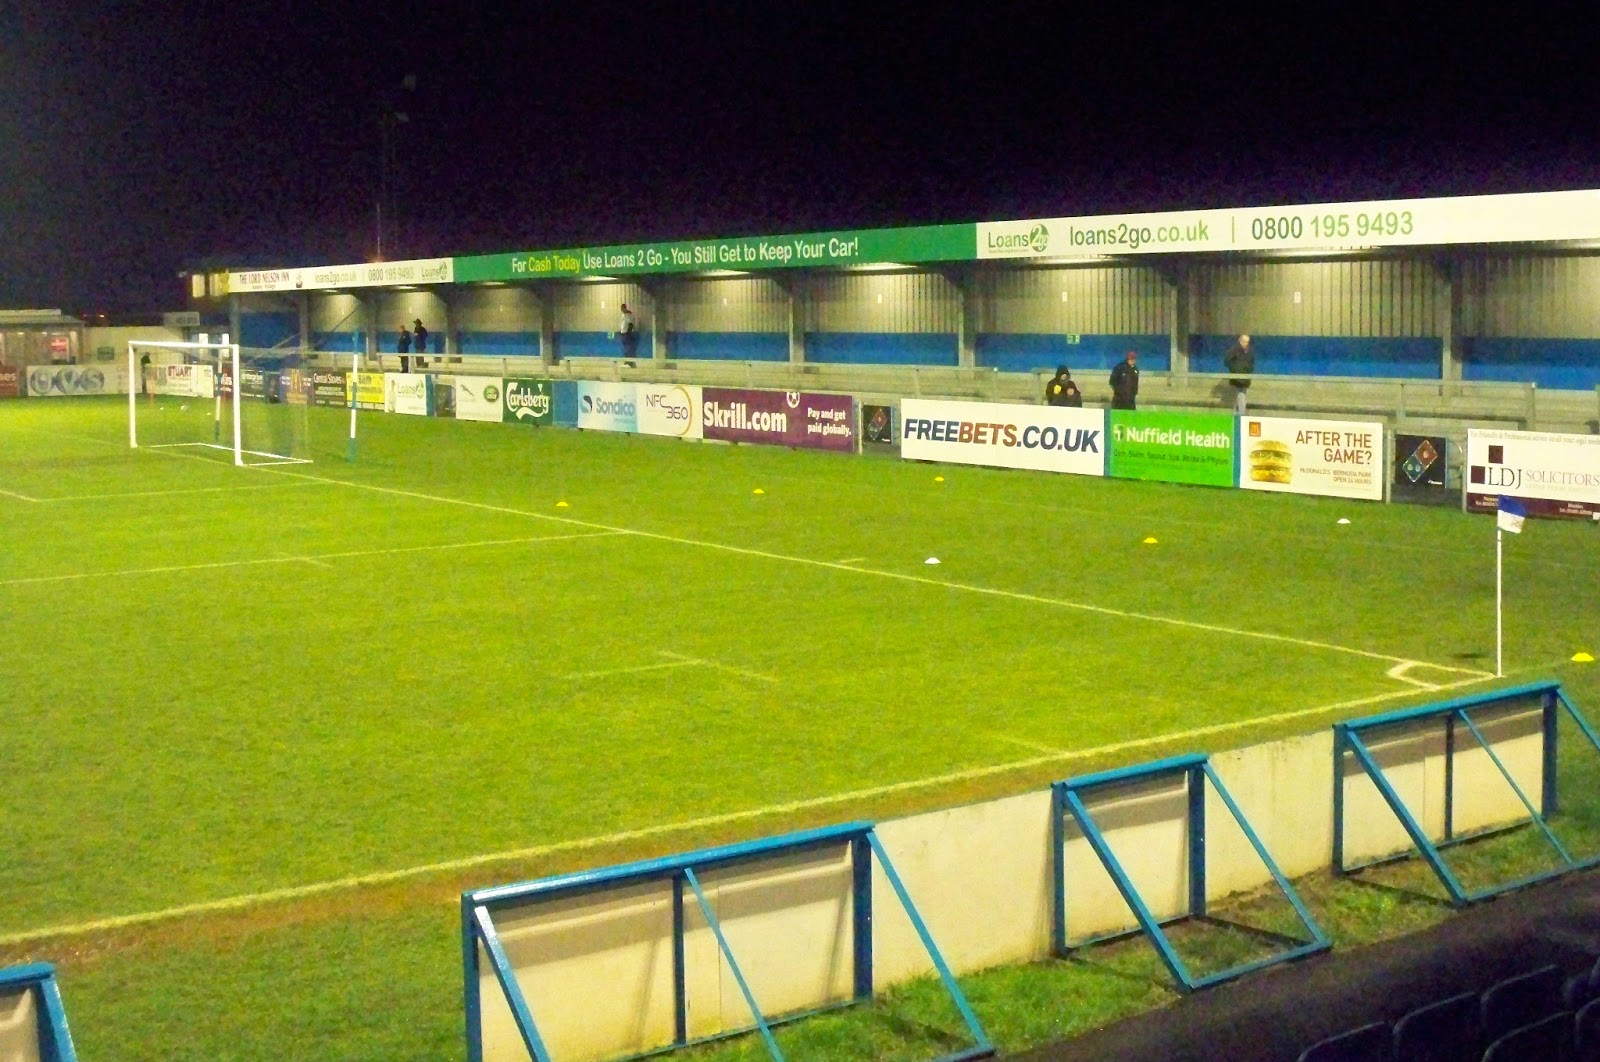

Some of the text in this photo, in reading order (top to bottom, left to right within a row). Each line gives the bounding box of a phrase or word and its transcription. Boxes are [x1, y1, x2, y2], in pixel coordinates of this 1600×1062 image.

[1070, 210, 1414, 249] loans2go.co.uk 0800 195 9493
[511, 257, 527, 273] For
[528, 256, 551, 272] Cash
[553, 254, 581, 273] Today
[583, 253, 603, 270] Use
[604, 251, 635, 269] Loans
[637, 249, 645, 266] 2
[646, 248, 662, 266] Go
[670, 247, 692, 265] You
[694, 245, 717, 264] Still
[719, 244, 742, 263] Get
[743, 243, 757, 262] to
[759, 242, 793, 264] Keep
[794, 239, 825, 259] Your
[828, 236, 859, 258] Car!
[239, 273, 247, 284] THE
[248, 272, 261, 284] LORD
[262, 272, 280, 283] NELSON
[368, 269, 384, 281] 0800
[168, 365, 193, 377] STUART
[505, 381, 550, 414] Carlsberg
[595, 396, 635, 416] Sondico
[645, 393, 667, 408] NFC
[666, 406, 689, 420] 360
[703, 401, 787, 433] Skrill.com
[807, 407, 846, 422] Pay and get
[807, 422, 852, 437] paid globally.
[903, 418, 1101, 454] FREEBETS.CO.UK
[1126, 426, 1230, 449] Nuffield Health
[1295, 429, 1373, 449] AFTER THE
[1323, 448, 1373, 465] GAME?
[1487, 467, 1522, 489] LDJ
[1525, 469, 1600, 487] SOLICITORS
